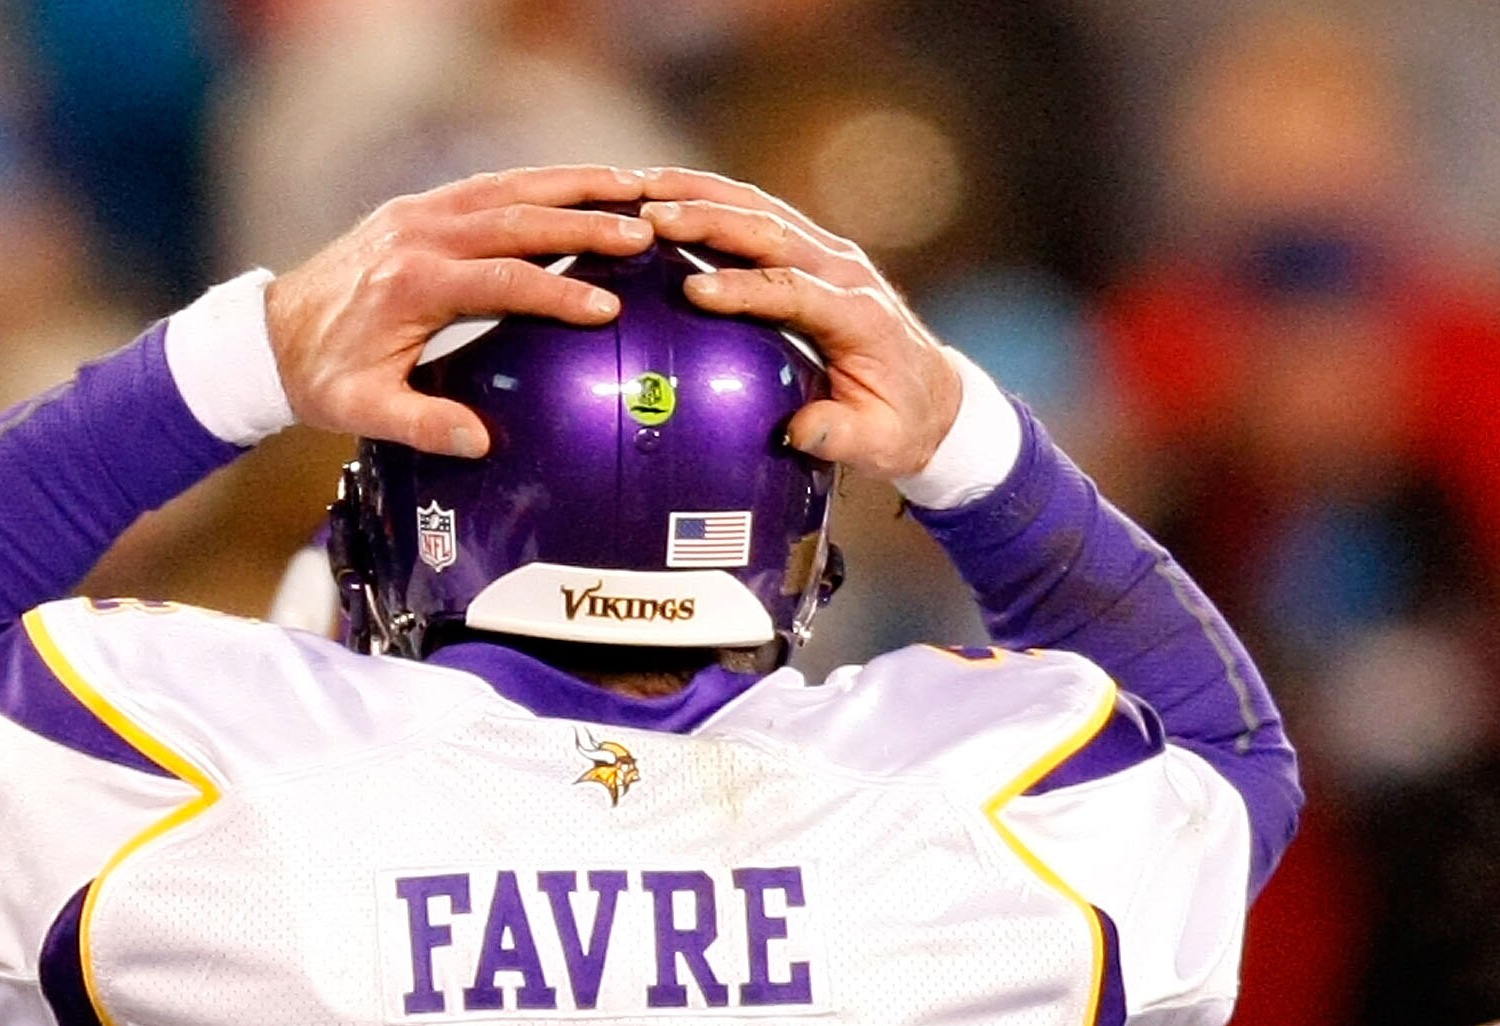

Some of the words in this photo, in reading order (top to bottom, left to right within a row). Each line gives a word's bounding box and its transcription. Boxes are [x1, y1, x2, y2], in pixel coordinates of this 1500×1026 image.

[422, 533, 452, 562] NFL
[560, 579, 696, 621] VIKINGS
[395, 866, 813, 1015] FAVRE
